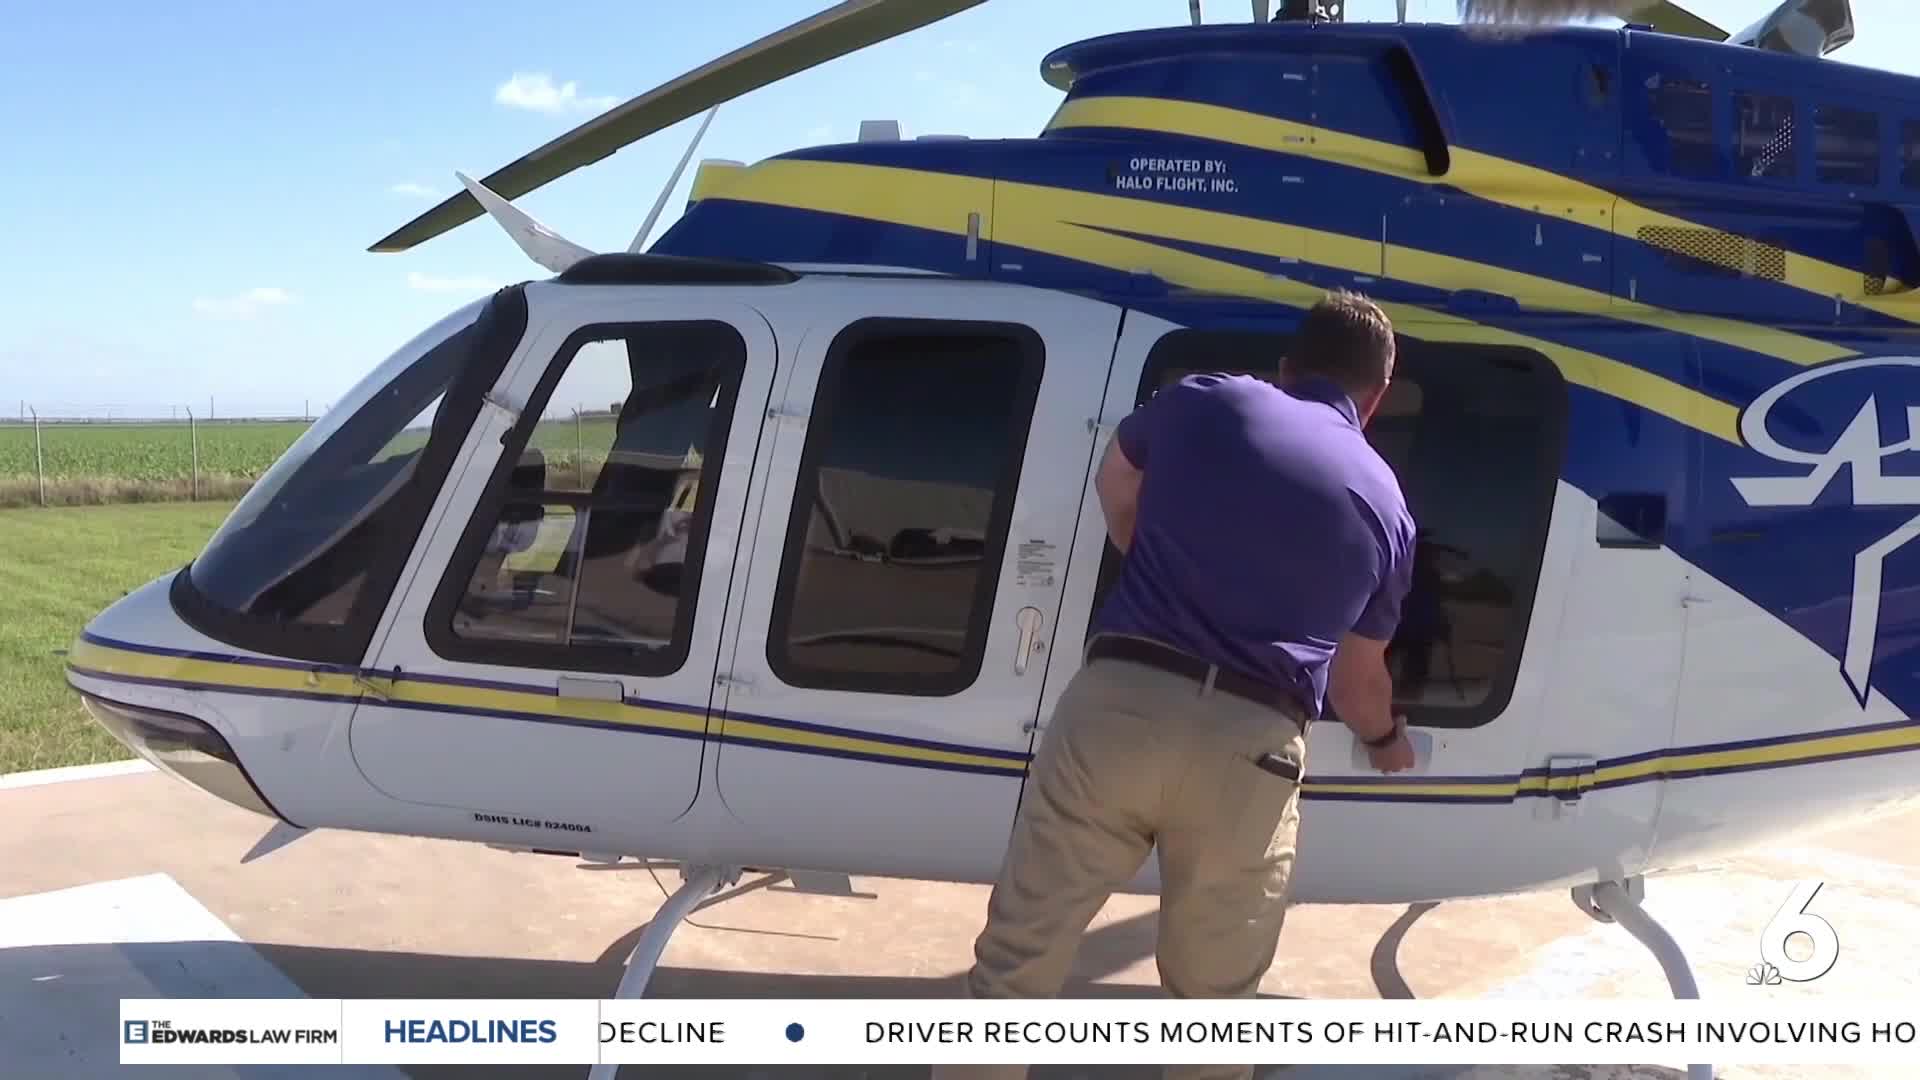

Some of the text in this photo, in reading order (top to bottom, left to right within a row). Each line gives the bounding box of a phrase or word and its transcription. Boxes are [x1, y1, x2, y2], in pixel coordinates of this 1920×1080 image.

[1129, 158, 1227, 173] OPERATED BY:
[1116, 175, 1239, 192] HALO FLIGHT, INC.
[474, 812, 509, 824] DSHS
